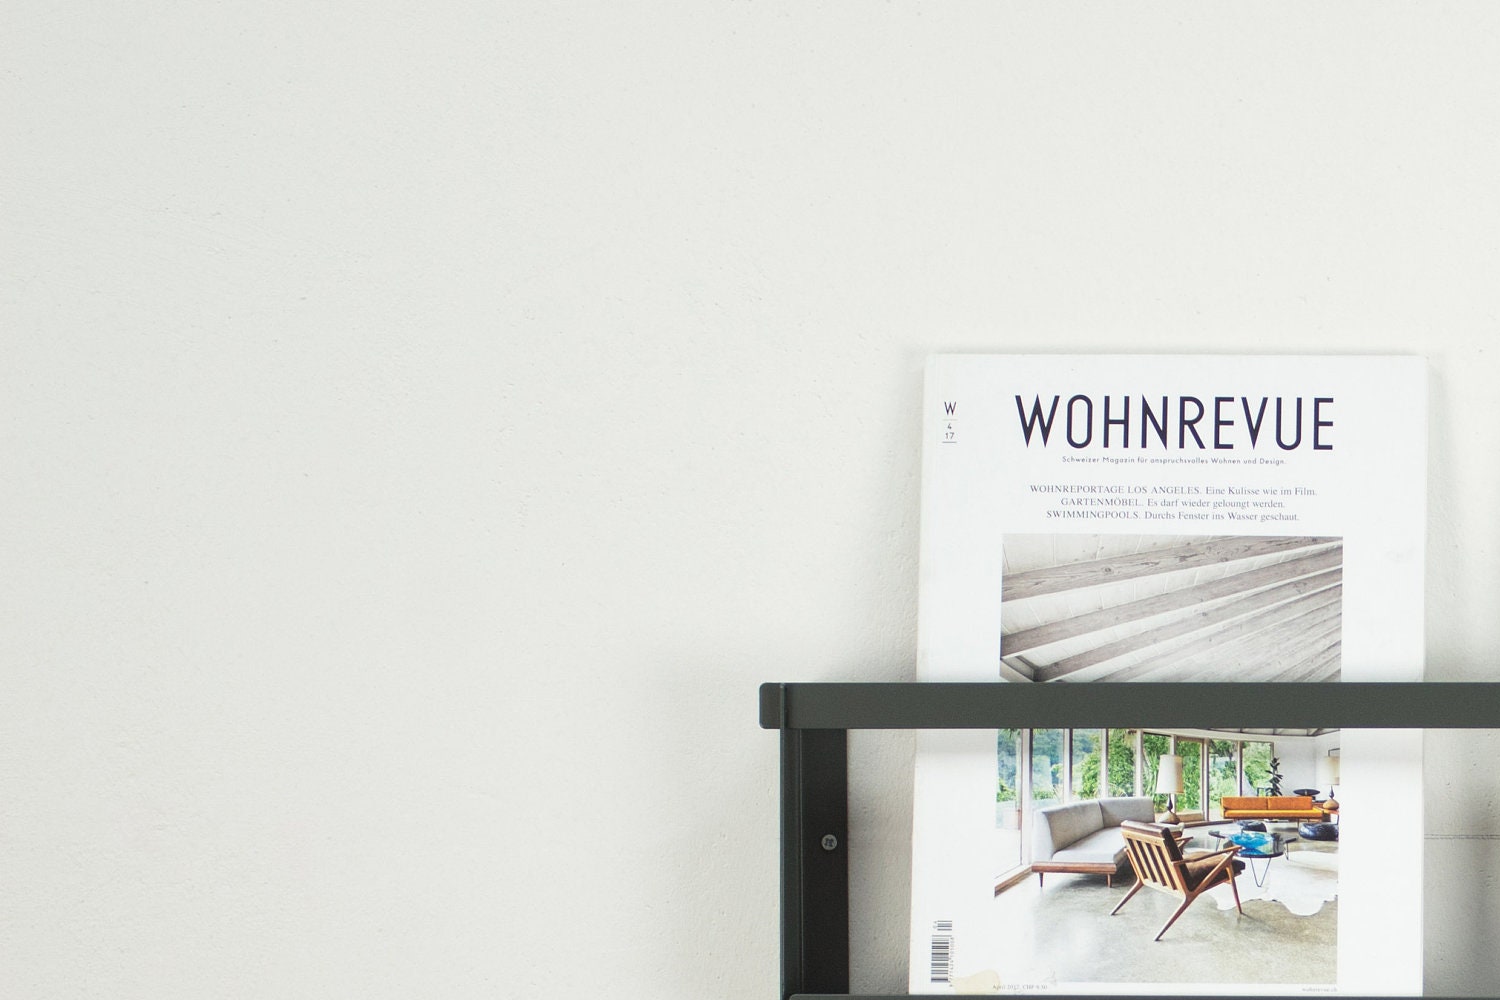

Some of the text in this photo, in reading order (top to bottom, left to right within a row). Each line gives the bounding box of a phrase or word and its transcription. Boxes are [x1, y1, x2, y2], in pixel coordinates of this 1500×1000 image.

[944, 401, 957, 416] W
[1015, 394, 1333, 450] WOHNREVUE
[1062, 455, 1099, 463] Schweizer
[1102, 456, 1134, 465] Magazin
[1210, 457, 1240, 465] Wohnen
[1243, 457, 1256, 465] und
[1030, 485, 1124, 494] WOHNREPORTAGE
[1127, 486, 1147, 494] LOS
[1205, 487, 1225, 495] Eine
[1228, 487, 1260, 496] Kulisse
[1263, 488, 1278, 496] wie
[1294, 487, 1317, 496] Film.
[1160, 498, 1178, 507] darf
[1181, 499, 1210, 508] wieder
[1212, 499, 1250, 511] geloungt
[1252, 500, 1285, 508] werden.
[1144, 511, 1176, 520] Durchs
[1178, 511, 1209, 520] Fenster
[1212, 512, 1225, 520] ins
[1227, 511, 1258, 521] Wasser
[1260, 512, 1299, 523] geschaut.
